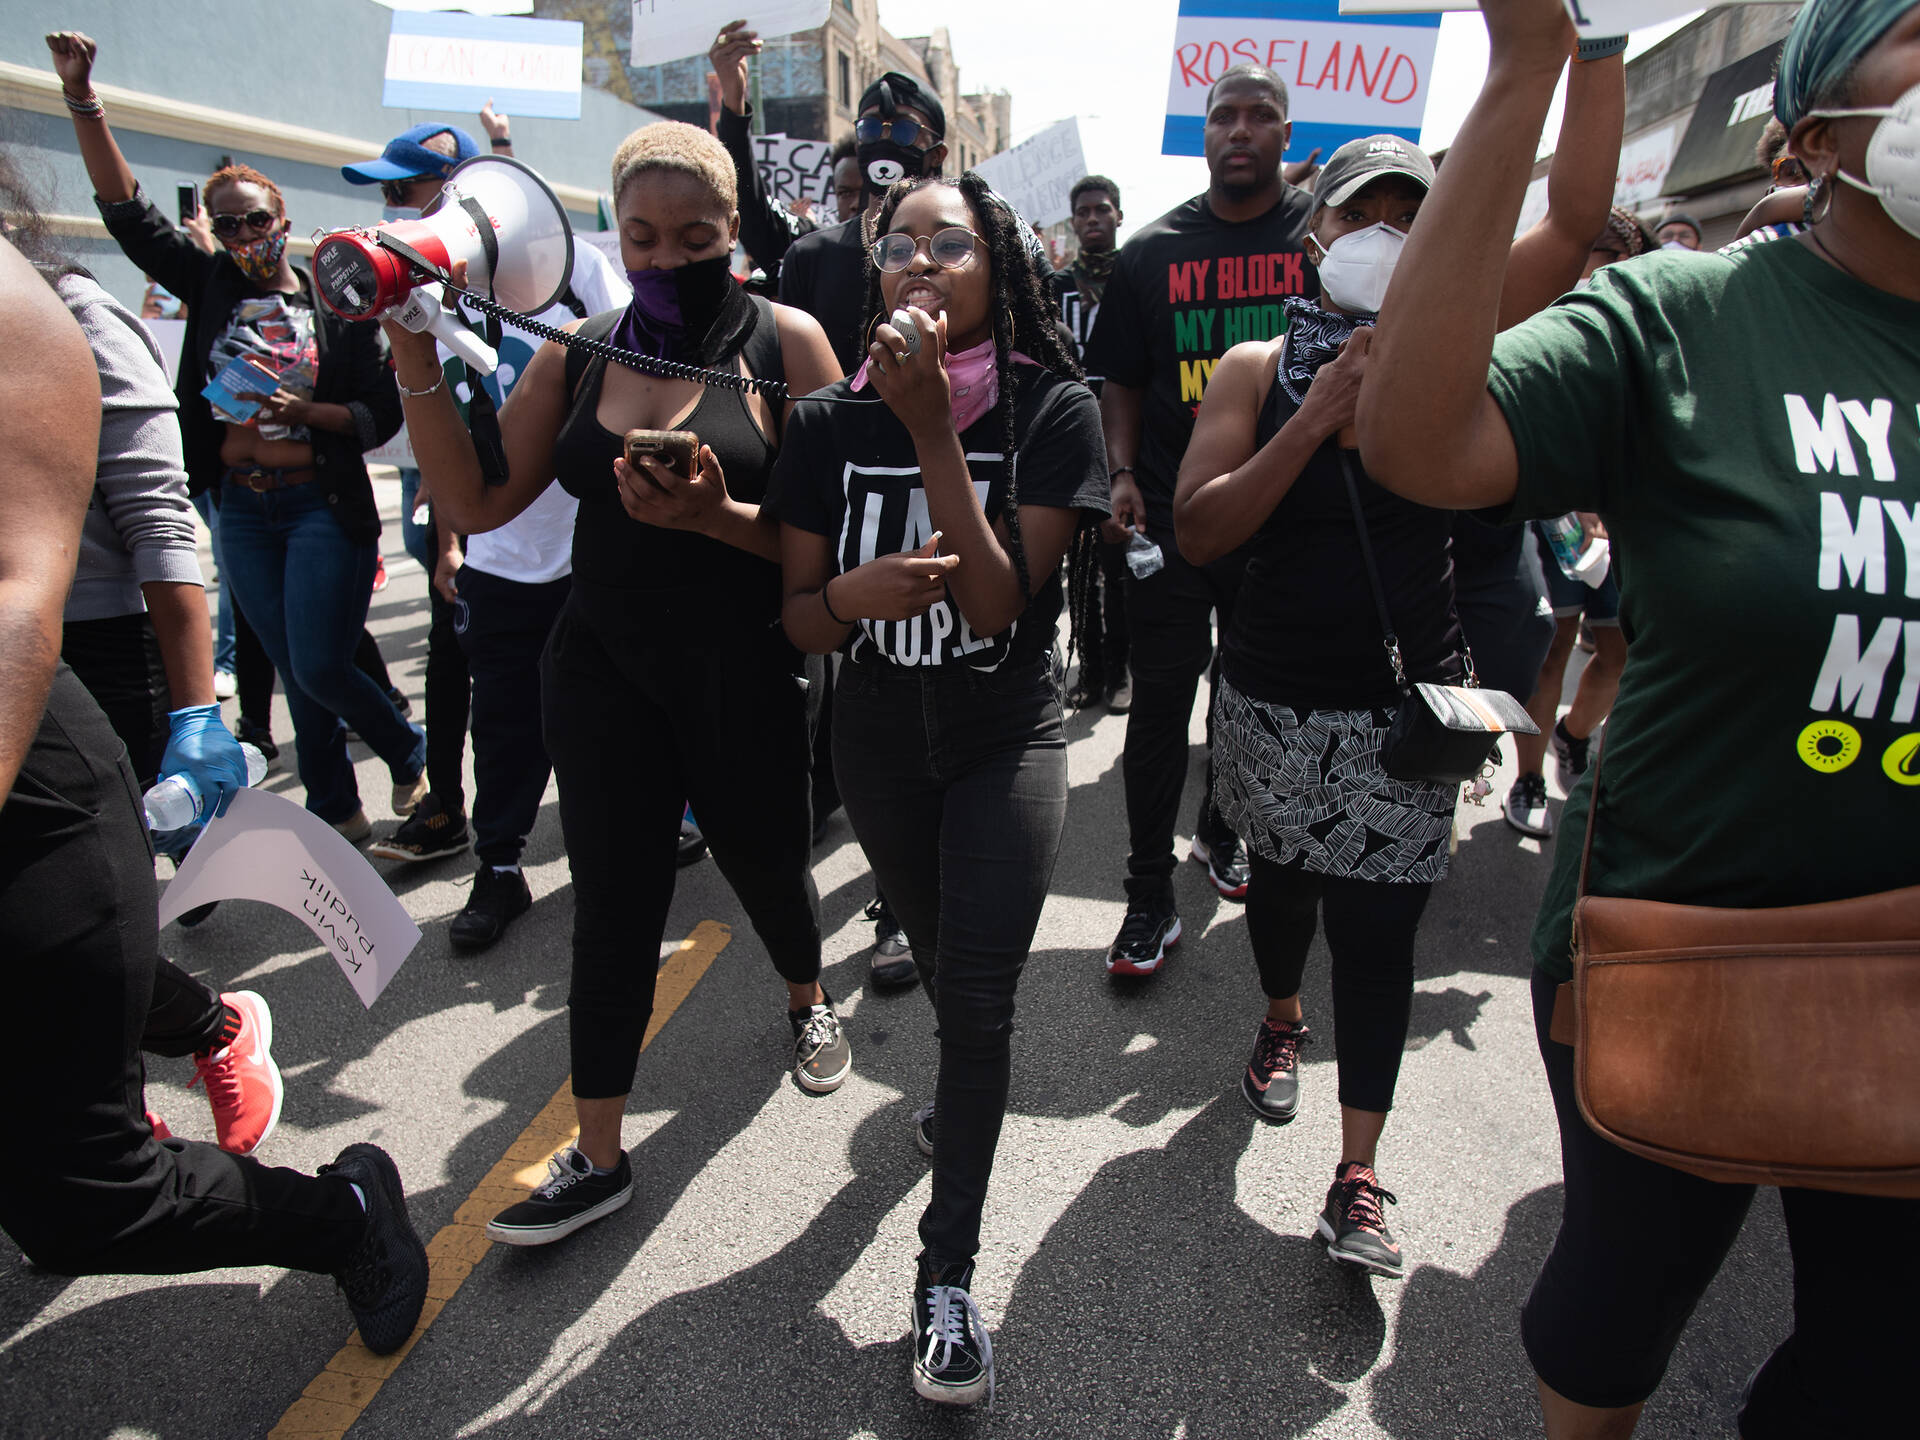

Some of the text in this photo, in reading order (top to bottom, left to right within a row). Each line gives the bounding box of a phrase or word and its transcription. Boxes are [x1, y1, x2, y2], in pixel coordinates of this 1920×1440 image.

[1176, 38, 1418, 104] ROSELAND
[756, 138, 779, 167] I
[320, 245, 339, 266] PYLE
[1168, 252, 1304, 304] MY BLOCK
[403, 305, 421, 325] PYLE
[1174, 308, 1216, 353] MY
[1783, 392, 1896, 482] MY
[1817, 491, 1920, 600] MY
[303, 899, 362, 974] Kevin
